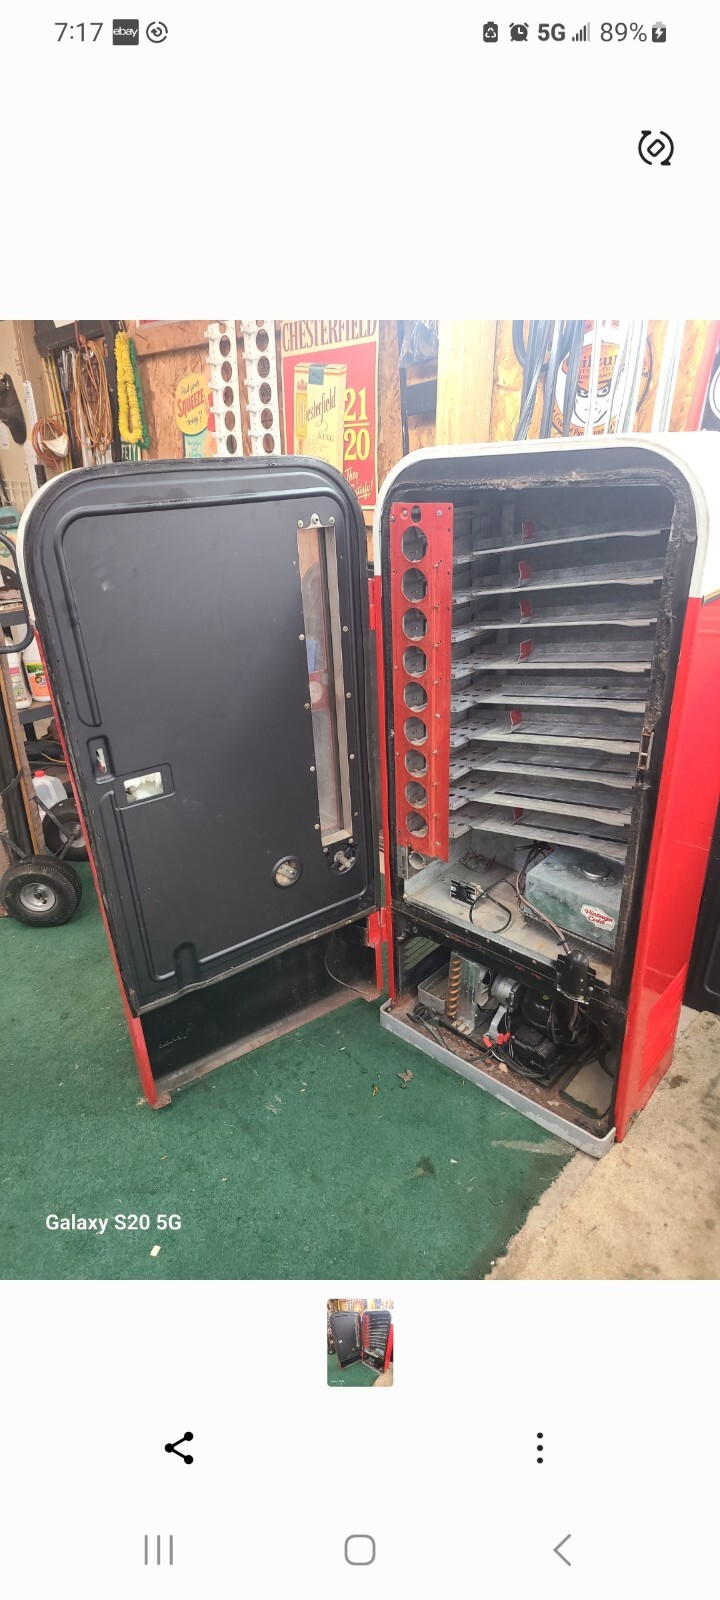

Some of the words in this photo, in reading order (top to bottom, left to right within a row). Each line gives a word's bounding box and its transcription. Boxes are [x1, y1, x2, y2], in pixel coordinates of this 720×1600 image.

[54, 22, 103, 41] 7:17
[113, 27, 138, 37] ebay
[537, 22, 566, 42] 5G
[600, 22, 647, 42] 89%
[282, 319, 377, 352] CHESTERFIELD
[177, 387, 204, 418] SQUEEZE
[343, 386, 369, 422] 21
[121, 443, 138, 461] FETY
[343, 428, 370, 461] 20
[344, 466, 359, 484] They
[584, 908, 614, 923] Vintage
